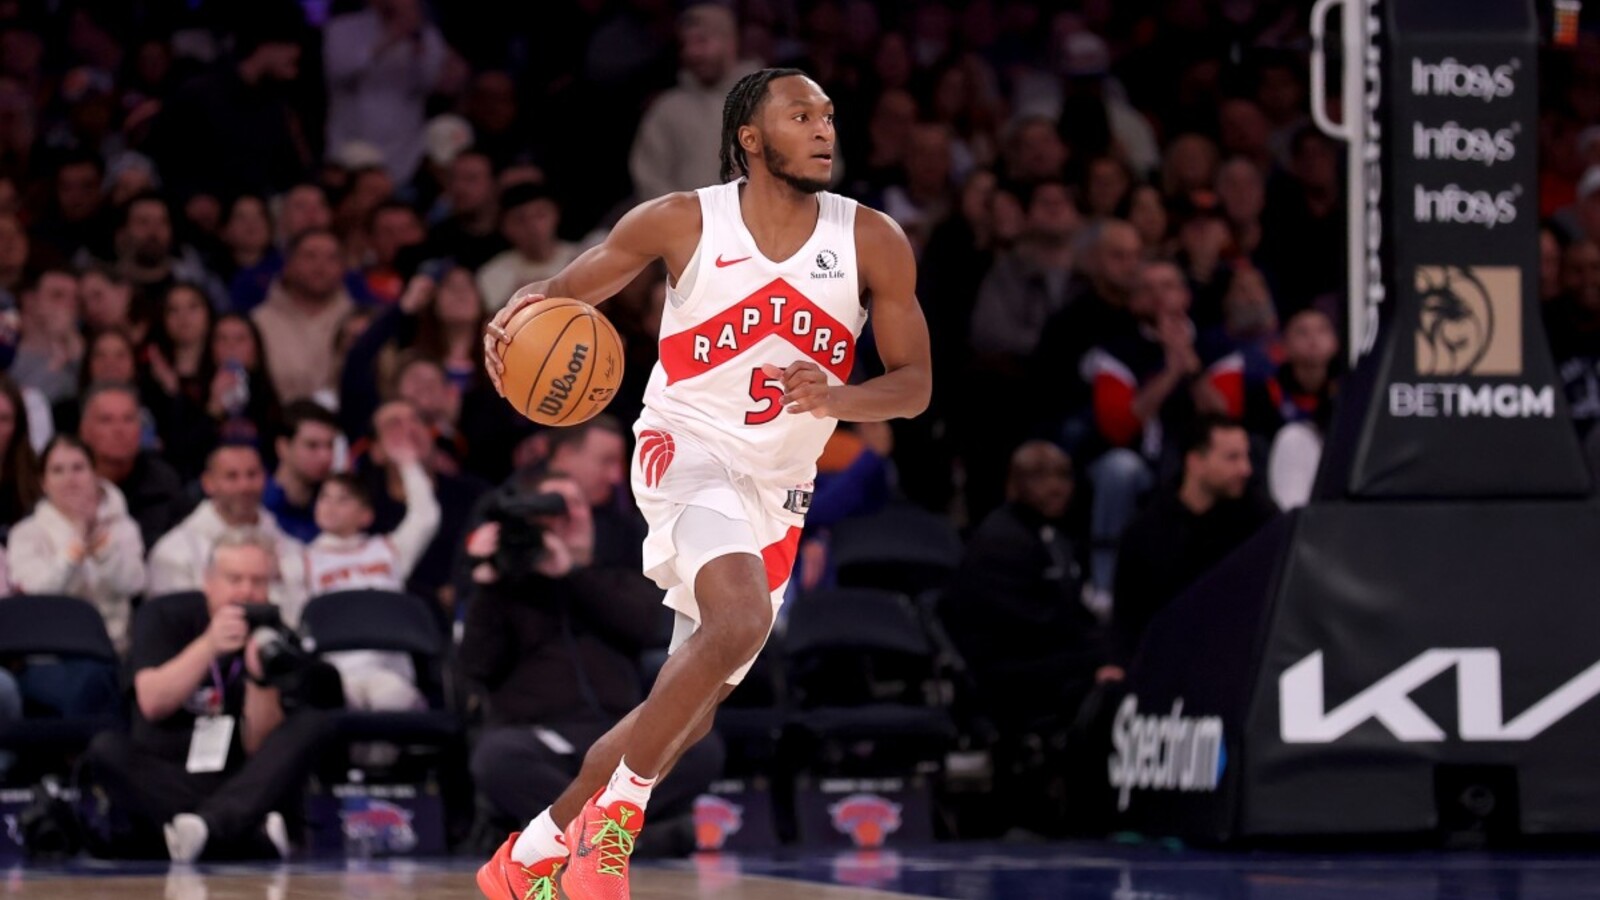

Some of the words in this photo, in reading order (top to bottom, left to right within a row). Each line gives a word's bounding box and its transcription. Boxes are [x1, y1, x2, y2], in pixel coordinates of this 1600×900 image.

[1412, 57, 1515, 103] Infosys
[1413, 120, 1516, 166] Infosys
[1414, 183, 1517, 229] Infosys
[829, 270, 845, 279] Life
[694, 296, 849, 366] RAPTORS
[536, 344, 589, 416] Wilson
[745, 367, 784, 425] 5
[1389, 383, 1555, 418] BETMGM
[1108, 693, 1223, 812] Spectrum
